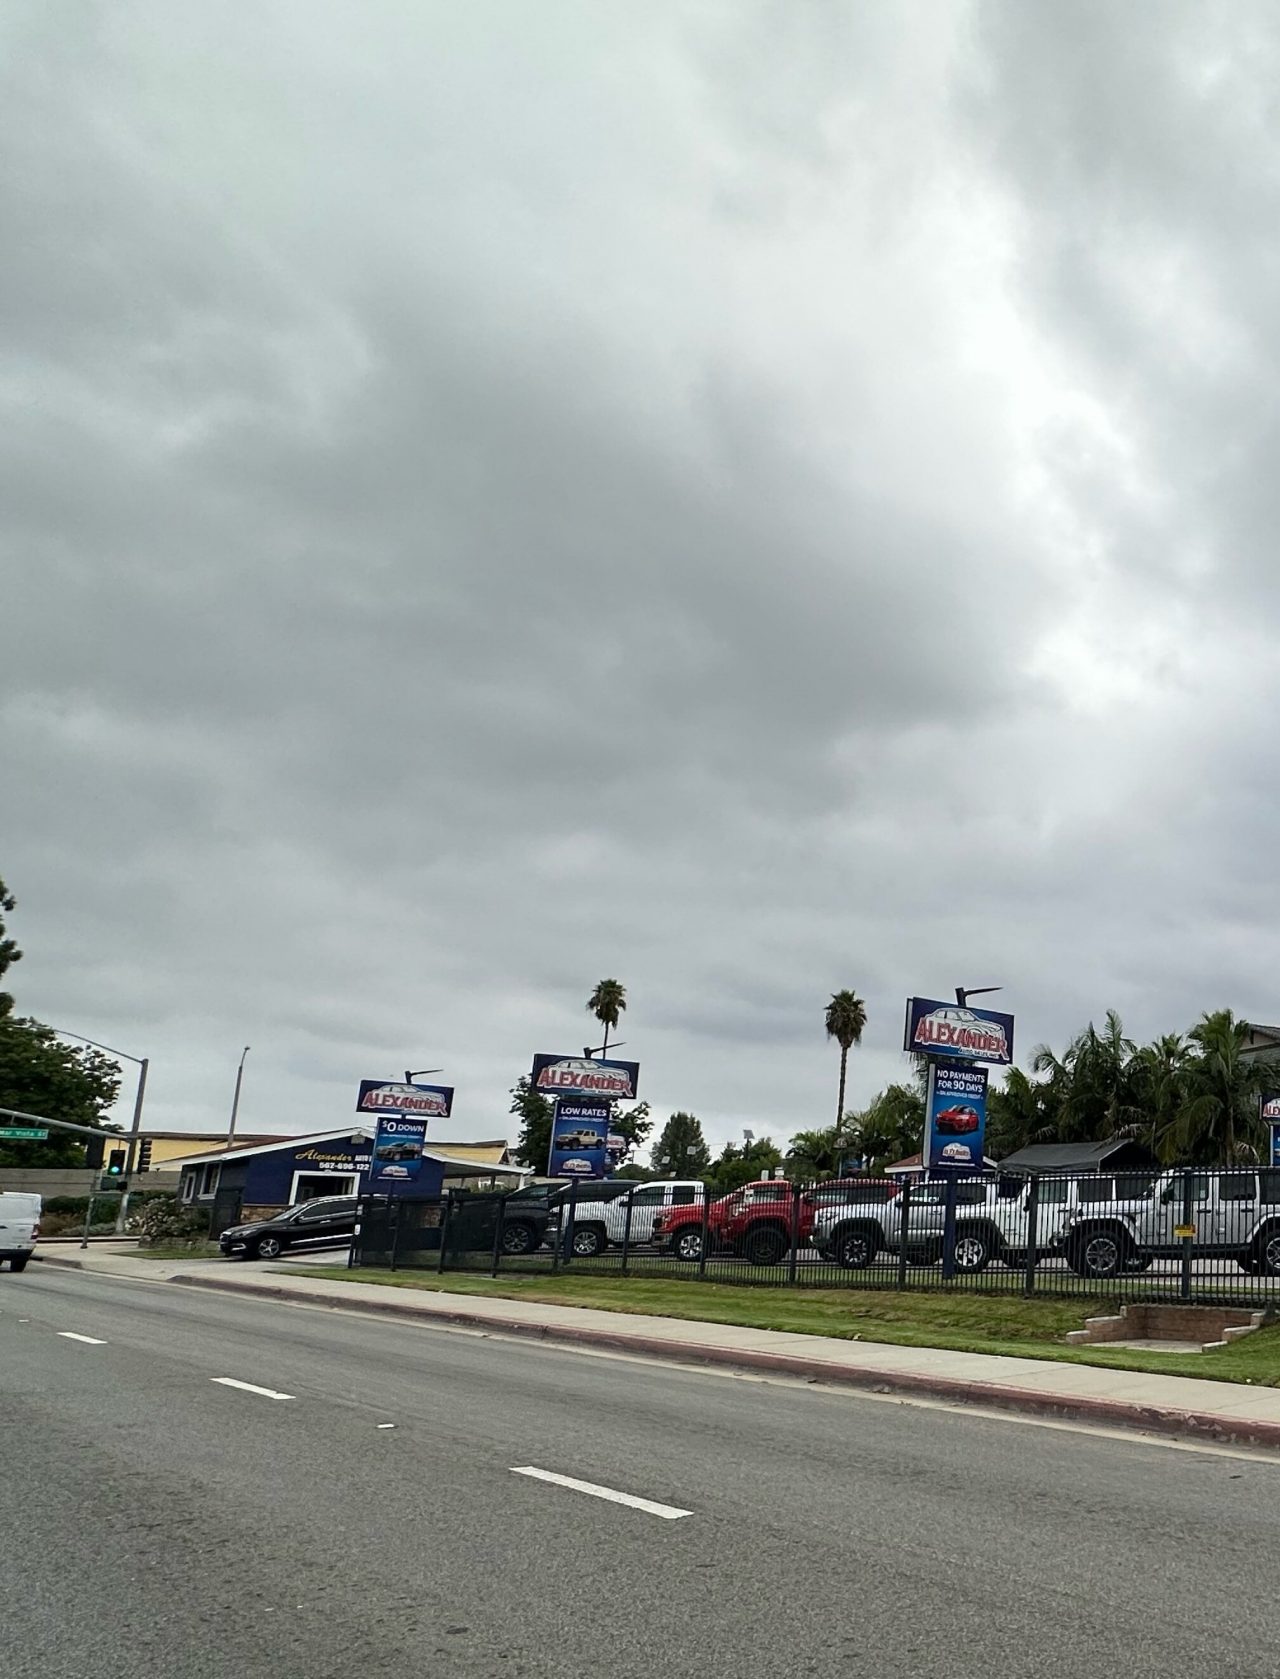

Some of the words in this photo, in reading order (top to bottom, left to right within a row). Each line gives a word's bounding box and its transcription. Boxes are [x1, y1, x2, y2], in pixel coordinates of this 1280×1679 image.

[914, 1016, 1010, 1060] ALEXANDER
[537, 1067, 633, 1096] ALEXANDER
[937, 1069, 949, 1079] NO
[949, 1070, 985, 1083] PAYMENTS
[938, 1079, 952, 1089] FOR
[953, 1080, 965, 1090] 90
[966, 1083, 983, 1093] DAYS
[361, 1091, 448, 1116] ALEXANDER
[560, 1106, 580, 1115] LOW
[581, 1107, 607, 1116] RATES
[382, 1120, 397, 1133] $0
[397, 1123, 424, 1133] DOWN
[295, 1149, 352, 1161] Alexander
[319, 1161, 370, 1171] 562-696-122
